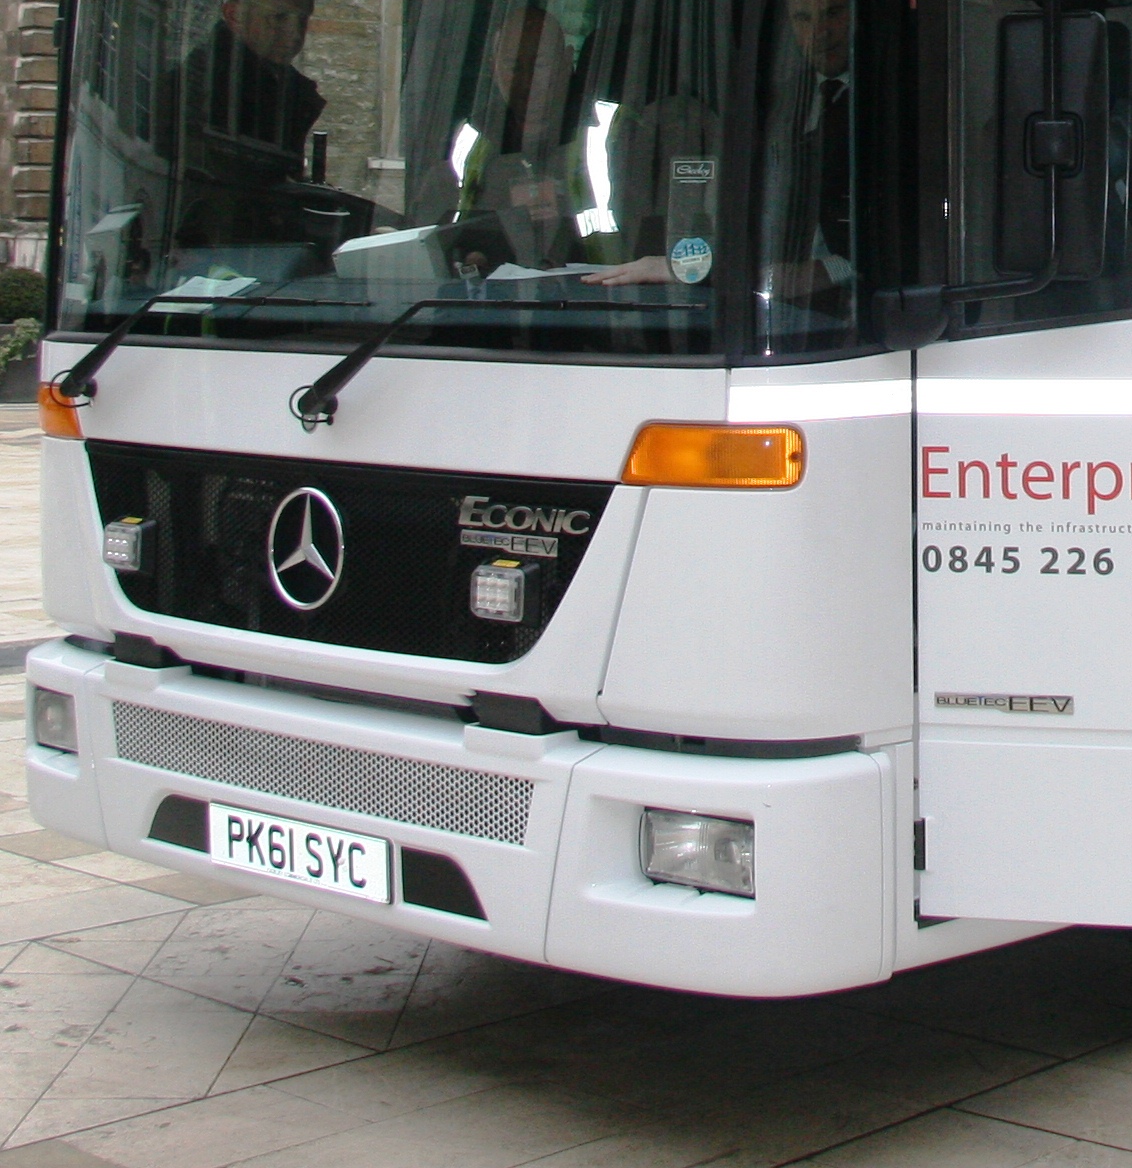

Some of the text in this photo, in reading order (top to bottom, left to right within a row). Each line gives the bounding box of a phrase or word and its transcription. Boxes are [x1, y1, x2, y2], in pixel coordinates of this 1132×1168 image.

[458, 495, 591, 535] ECONIC
[922, 520, 1012, 535] maintaining
[1019, 522, 1043, 533] the
[922, 544, 1021, 574] 0845
[1040, 547, 1115, 576] 226
[936, 695, 1071, 712] BLUETEC EEV
[227, 814, 367, 889] PK61 SYC
